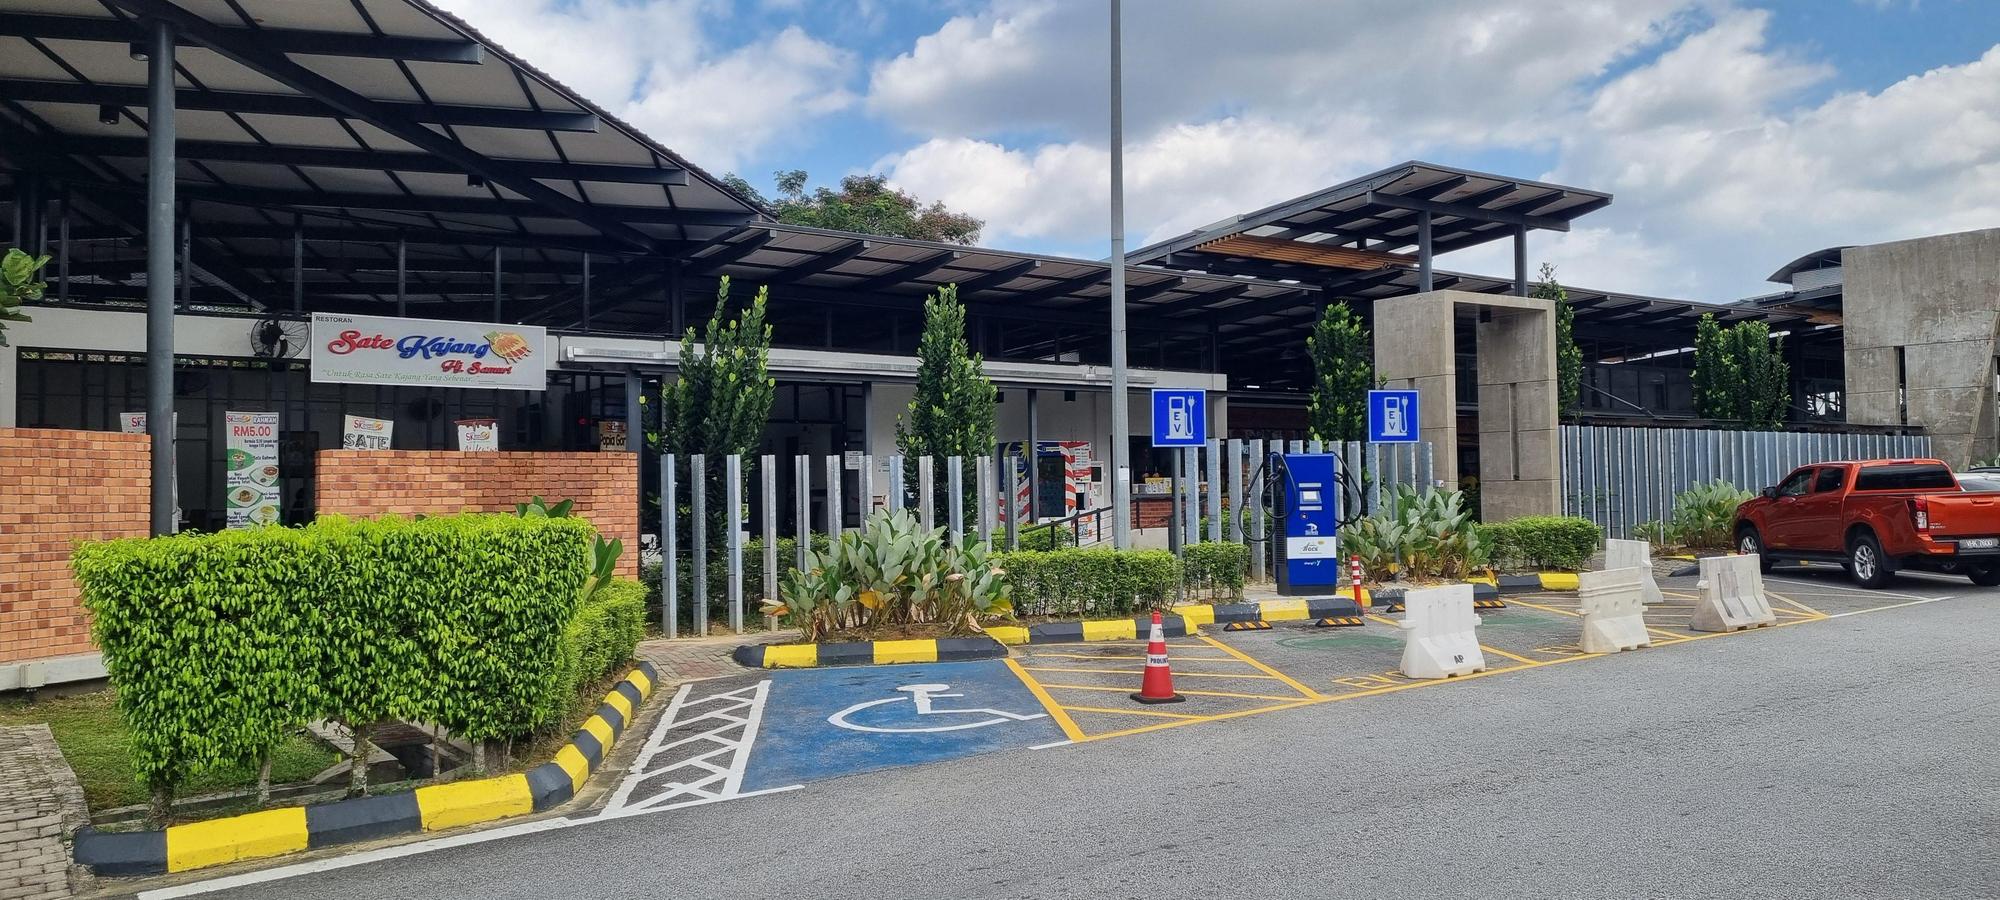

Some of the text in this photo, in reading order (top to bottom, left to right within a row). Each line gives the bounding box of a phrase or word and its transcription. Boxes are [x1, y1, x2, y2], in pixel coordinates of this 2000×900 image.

[328, 330, 490, 360] Sate Kajang
[233, 425, 271, 437] RM5.00
[344, 433, 389, 450] SATE
[1453, 654, 1465, 665] AP
